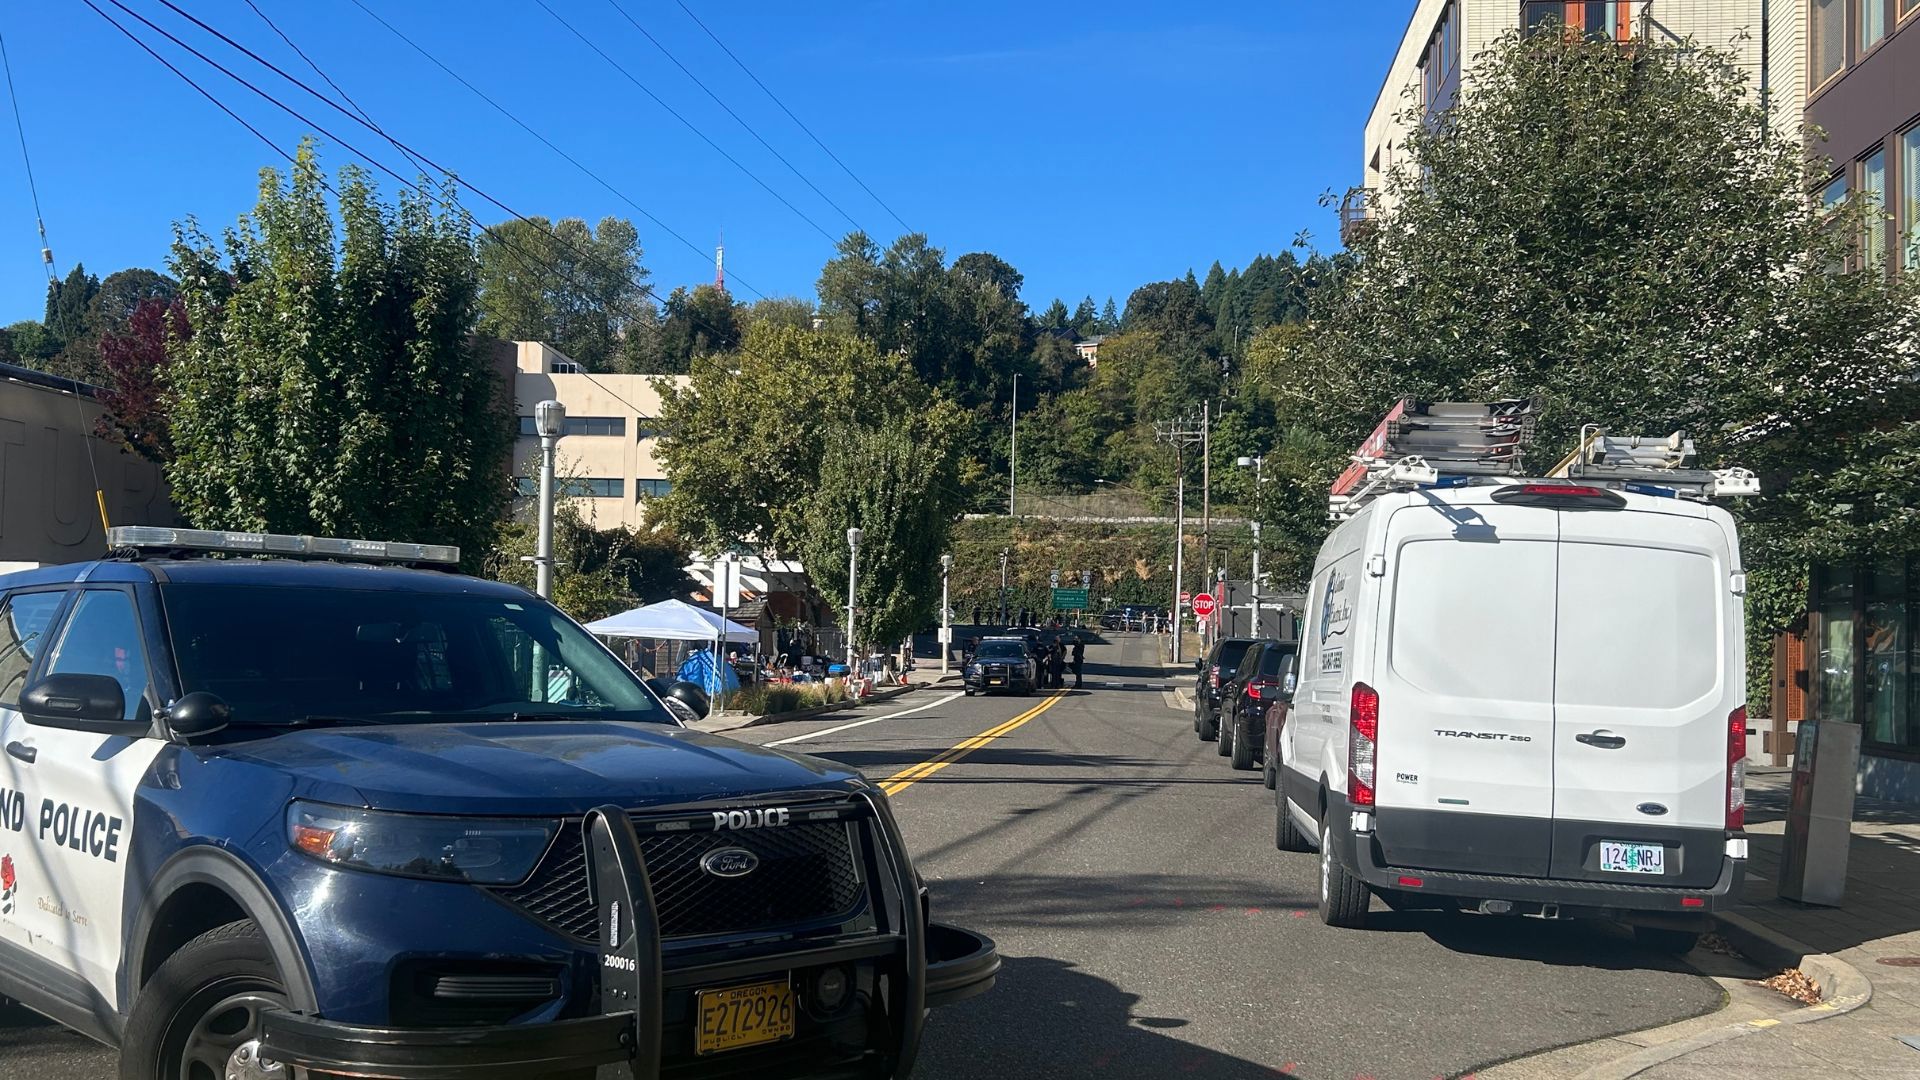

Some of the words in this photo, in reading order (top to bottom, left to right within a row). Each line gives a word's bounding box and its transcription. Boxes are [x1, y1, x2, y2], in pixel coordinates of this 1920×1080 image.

[1194, 600, 1214, 610] STOP
[1434, 729, 1509, 741] TRANSIT
[1396, 772, 1419, 782] POWER
[712, 807, 790, 832] POLICE
[39, 798, 122, 863] POLICE
[720, 855, 749, 872] Ford
[1606, 847, 1628, 865] 124
[1637, 849, 1662, 867] NRJ
[72, 910, 88, 928] Serve
[604, 954, 636, 972] 200016
[731, 987, 768, 1000] OREGON
[703, 992, 792, 1036] E272926
[704, 1033, 747, 1045] PUBLICLY
[762, 1024, 791, 1034] OWNED
